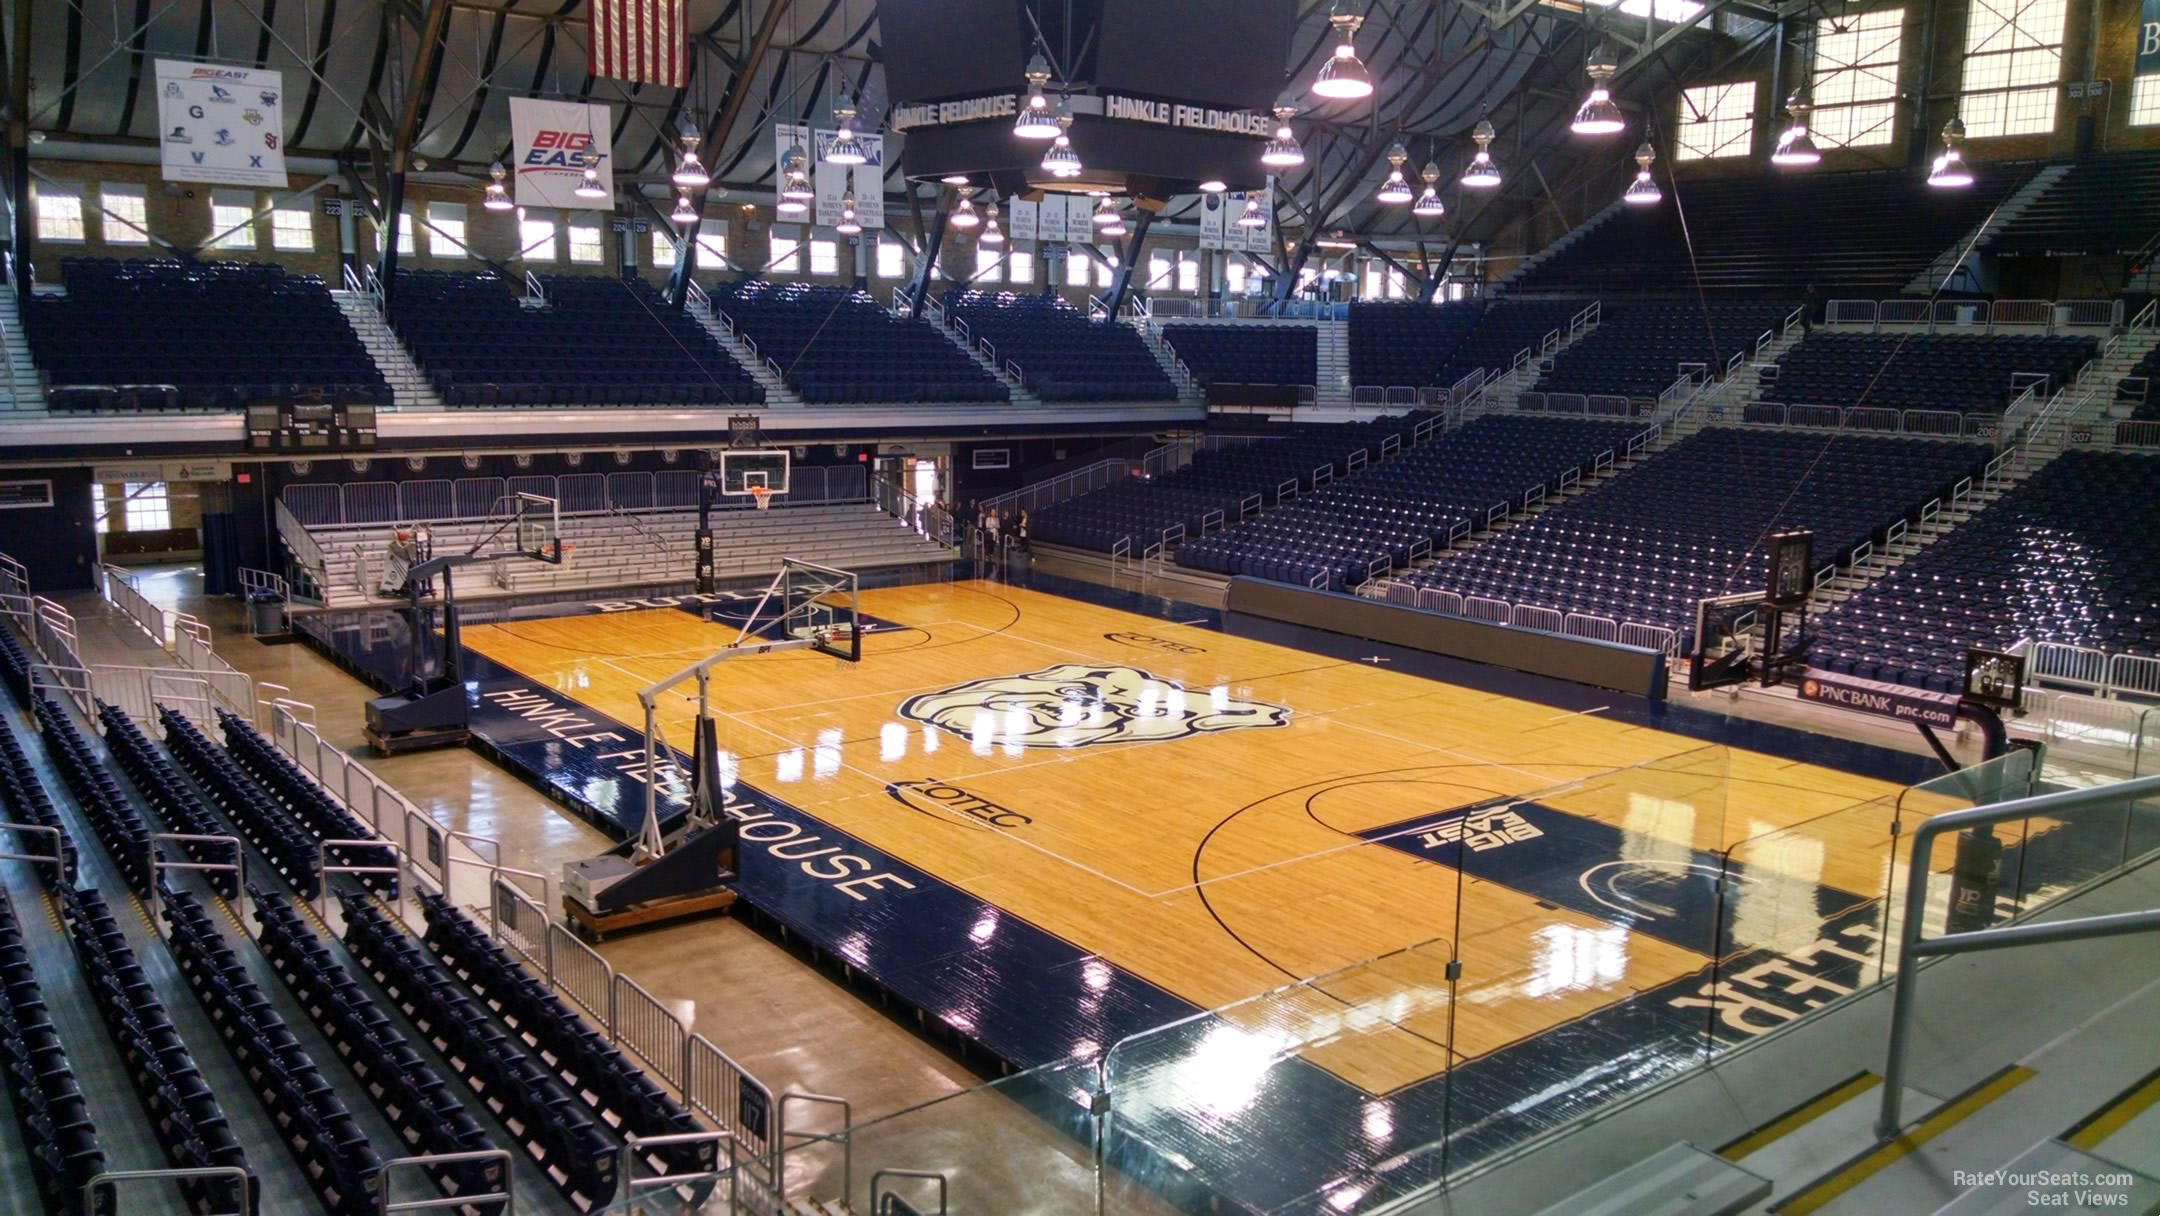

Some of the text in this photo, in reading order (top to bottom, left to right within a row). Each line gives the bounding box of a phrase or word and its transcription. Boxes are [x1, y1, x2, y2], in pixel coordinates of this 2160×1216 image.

[216, 70, 250, 79] EAST
[1106, 95, 1269, 135] HINKLE FIELDHOUSE
[532, 131, 592, 151] BIG
[523, 149, 608, 168] EAST
[1977, 427, 1995, 437] 206
[2071, 432, 2090, 442] 207
[1819, 684, 1950, 723] PNC BANK pnc.com
[483, 689, 626, 748] HINKLE
[1463, 822, 1545, 852] BIG
